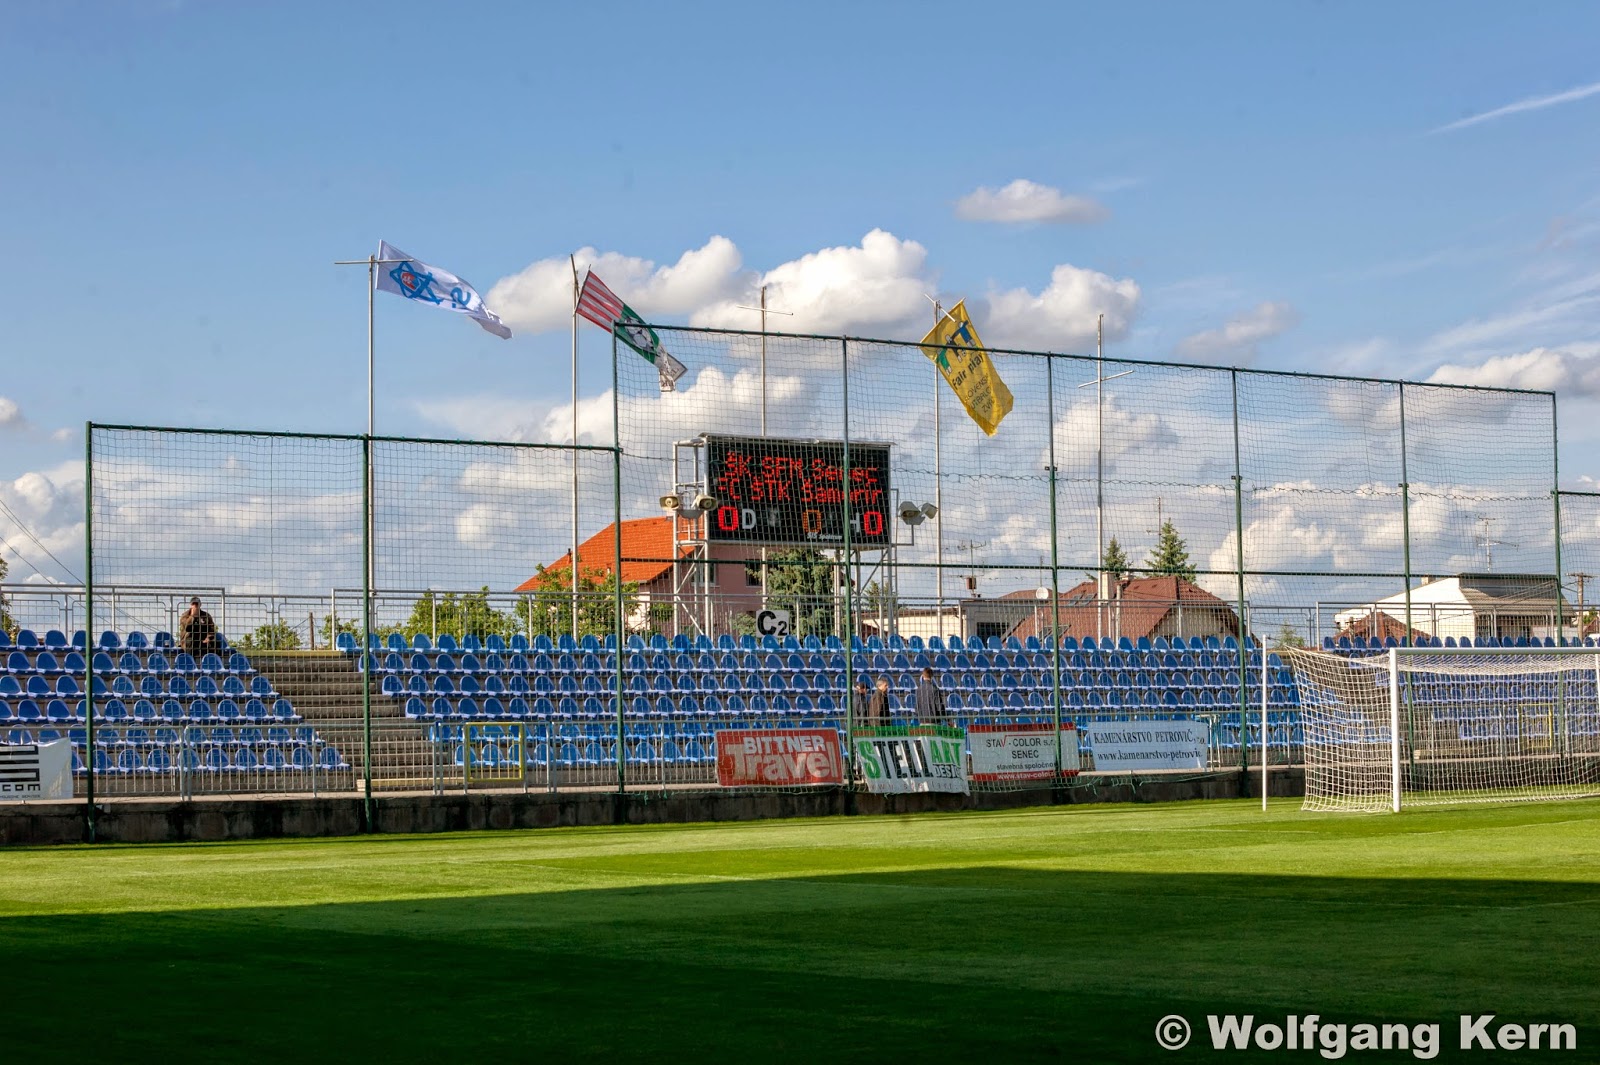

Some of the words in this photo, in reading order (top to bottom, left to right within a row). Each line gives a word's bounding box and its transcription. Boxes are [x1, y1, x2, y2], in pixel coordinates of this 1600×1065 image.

[741, 508, 756, 529] D
[743, 735, 827, 754] BITTNER
[986, 737, 1007, 748] STAV
[1013, 737, 1041, 748] COLOR
[1093, 730, 1153, 744] KAMENÁRSTVO
[724, 741, 838, 781] Travel
[1011, 749, 1039, 760] SENEC
